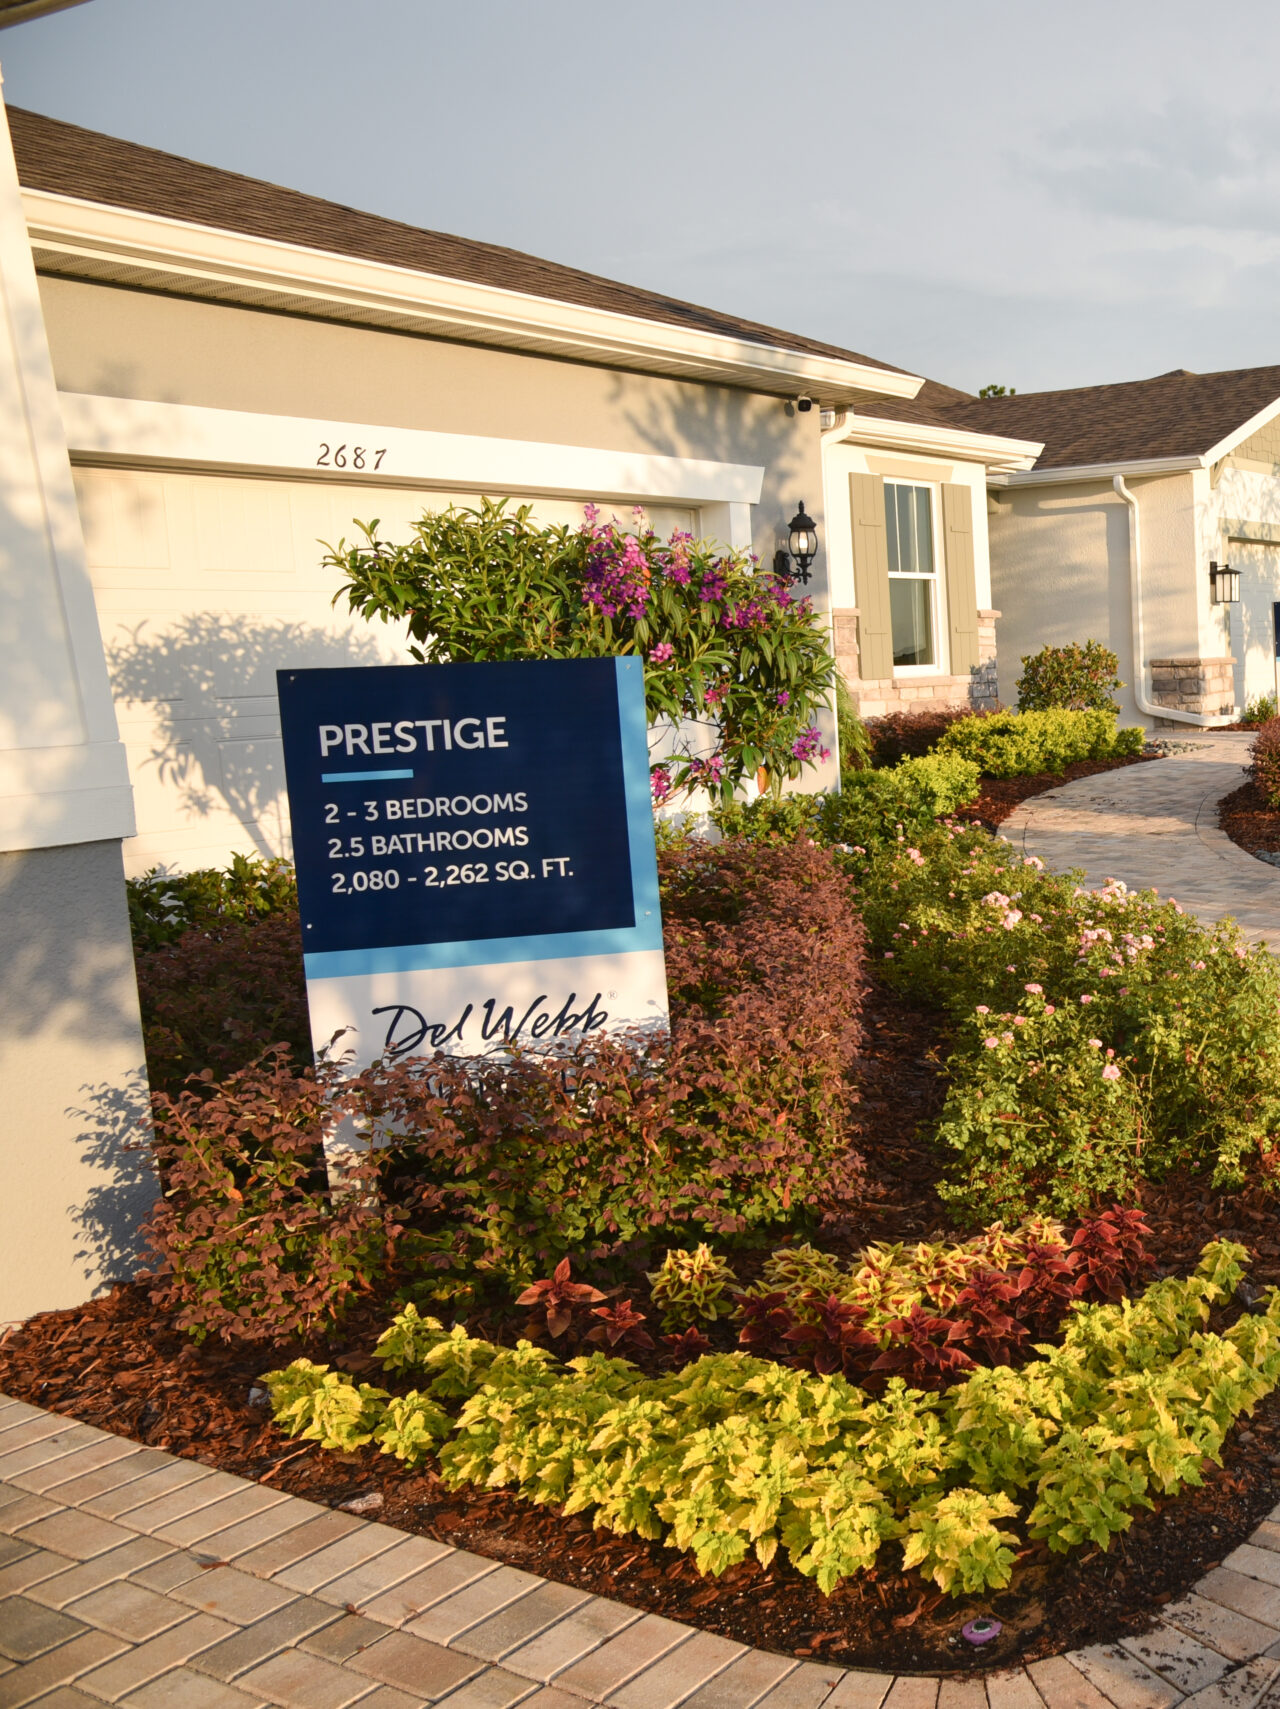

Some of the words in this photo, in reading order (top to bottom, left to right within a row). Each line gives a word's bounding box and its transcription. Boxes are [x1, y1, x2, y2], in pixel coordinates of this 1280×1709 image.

[317, 443, 387, 470] 2687
[319, 716, 509, 757] PRESTIGE
[324, 803, 340, 824] 2
[364, 801, 379, 821] 3
[385, 792, 529, 820] BEDROOMS
[327, 837, 365, 858] 2.5
[371, 826, 529, 856] BATHROOMS
[331, 869, 400, 895] 2,080
[424, 863, 490, 888] 2,262
[495, 860, 536, 882] SQ.
[541, 857, 574, 878] FT.
[372, 1003, 473, 1054] Del
[481, 992, 609, 1045] Webb
